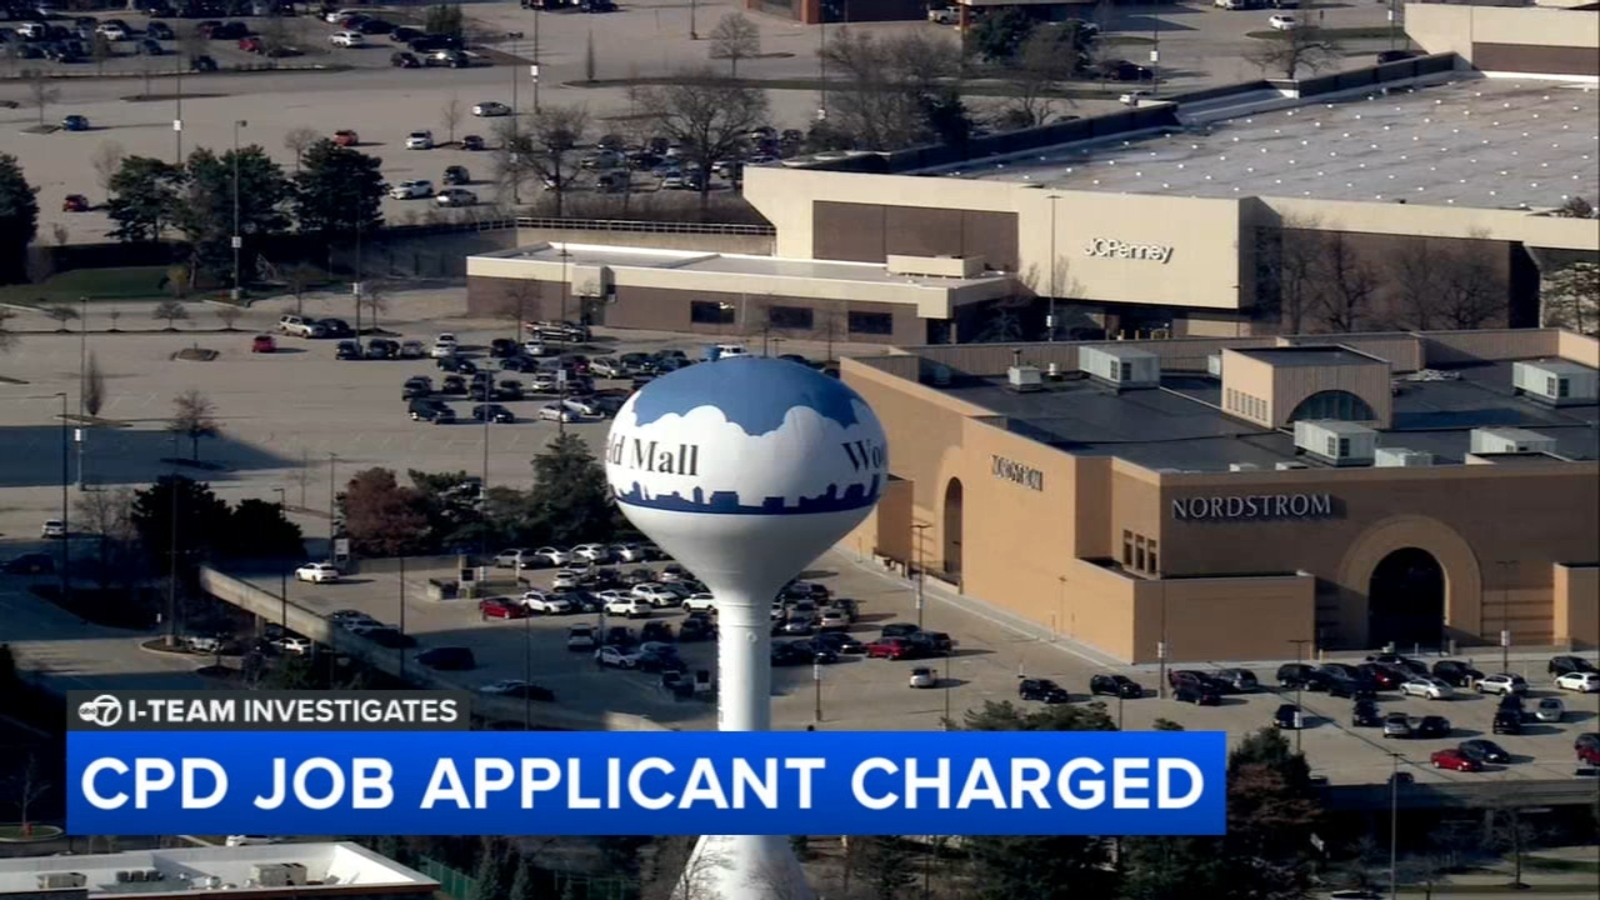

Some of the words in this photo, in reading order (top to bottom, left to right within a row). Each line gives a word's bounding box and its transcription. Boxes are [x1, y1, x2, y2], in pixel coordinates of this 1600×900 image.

[1085, 239, 1174, 265] JCPenney
[630, 438, 699, 476] Mall
[1172, 494, 1332, 519] NORDSTROM
